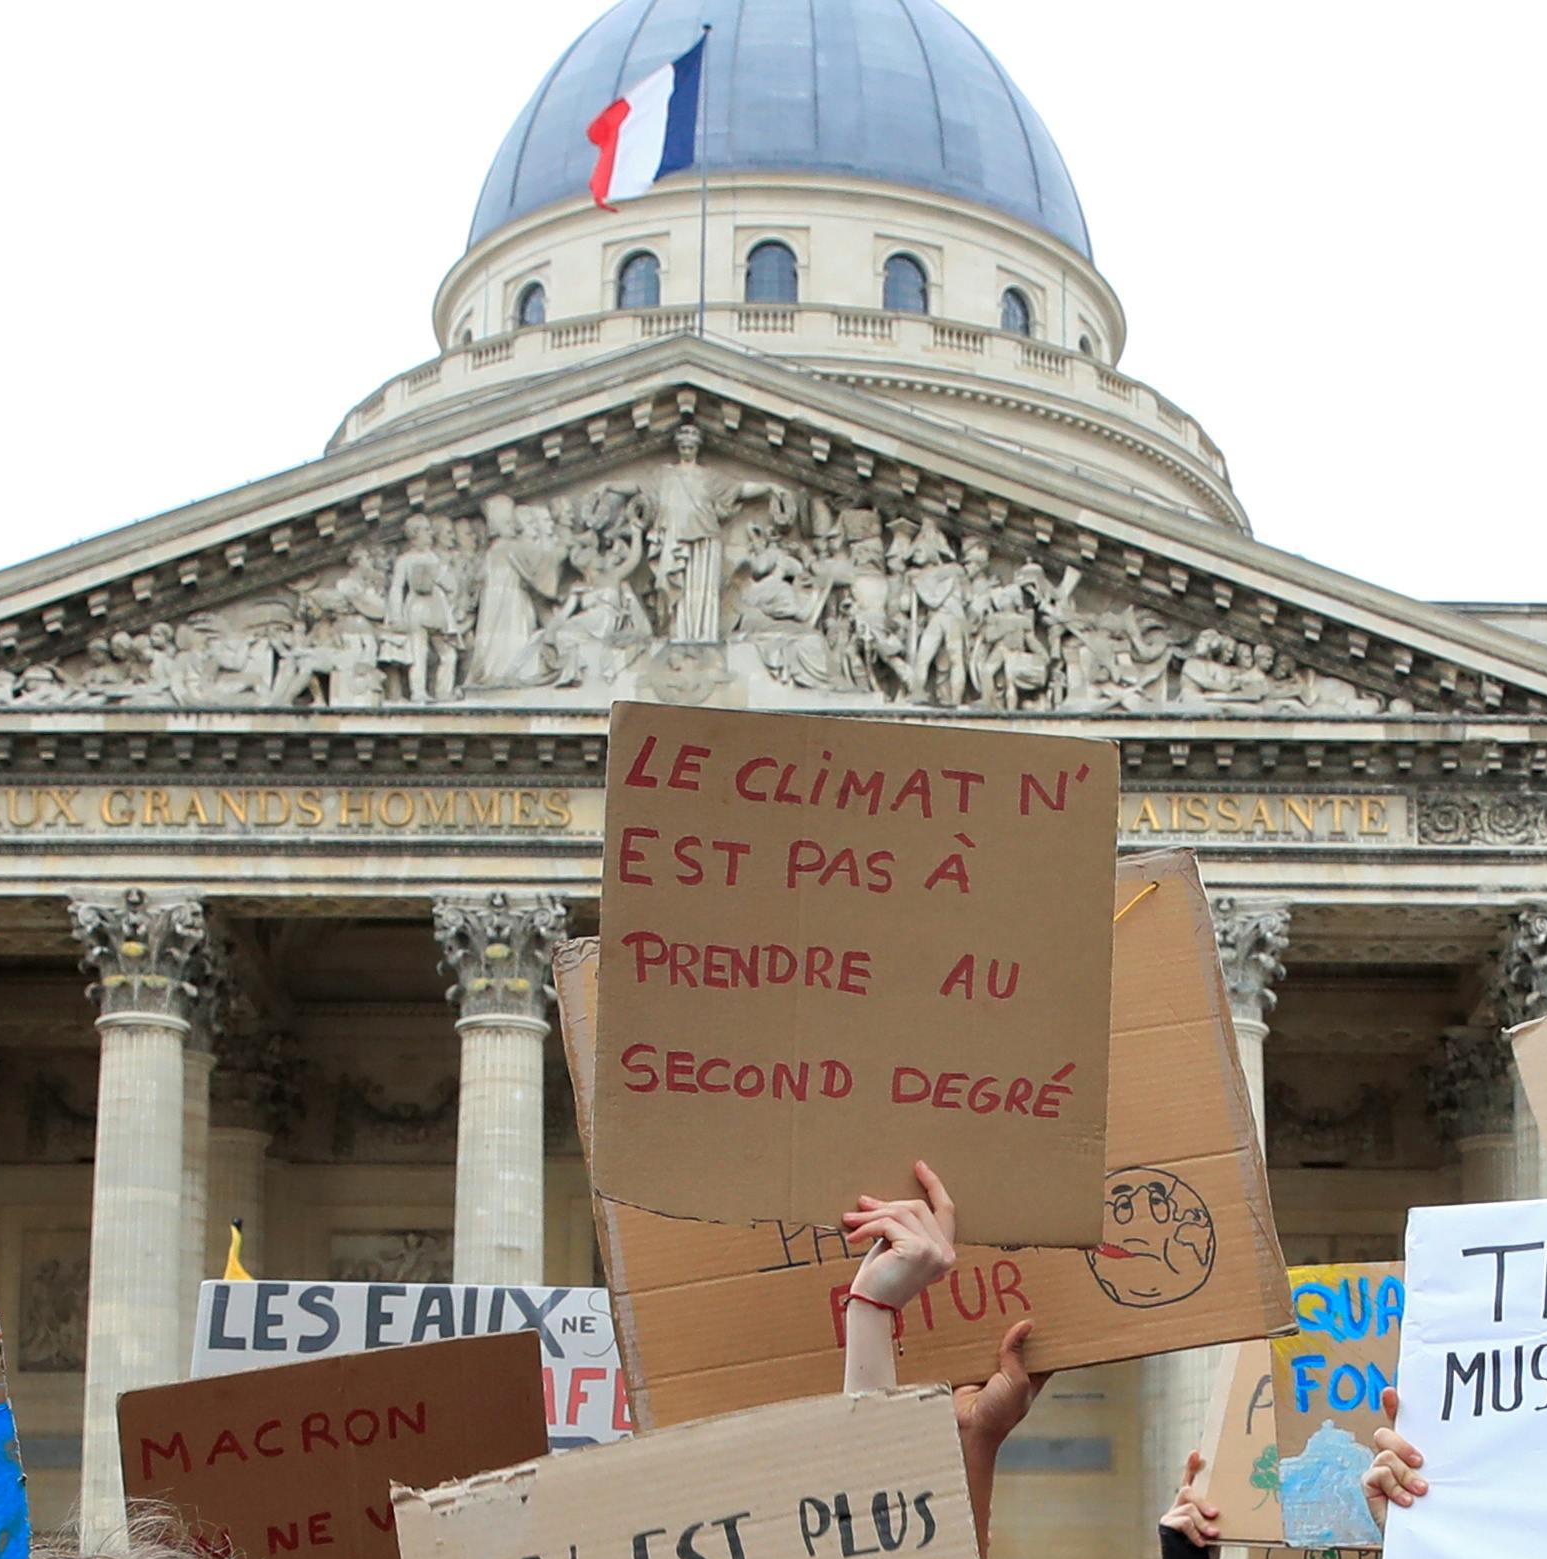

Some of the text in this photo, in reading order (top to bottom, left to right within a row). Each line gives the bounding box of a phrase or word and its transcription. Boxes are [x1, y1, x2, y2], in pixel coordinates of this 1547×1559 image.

[624, 736, 712, 791] LE
[100, 788, 325, 829] GRANDS
[339, 788, 573, 829] HOMMES
[1120, 795, 1390, 837] AISSANTE
[619, 826, 977, 894] EST PAS À
[621, 931, 1021, 1001] PRENDRE AU
[621, 1043, 1077, 1120] SECOND DEGRÉ
[208, 1284, 340, 1354] LES
[365, 1285, 571, 1359] EAUX
[561, 1316, 597, 1334] NE
[140, 1401, 426, 1480] MACRON
[266, 1511, 335, 1554] NE
[799, 1489, 938, 1559] PLUS
